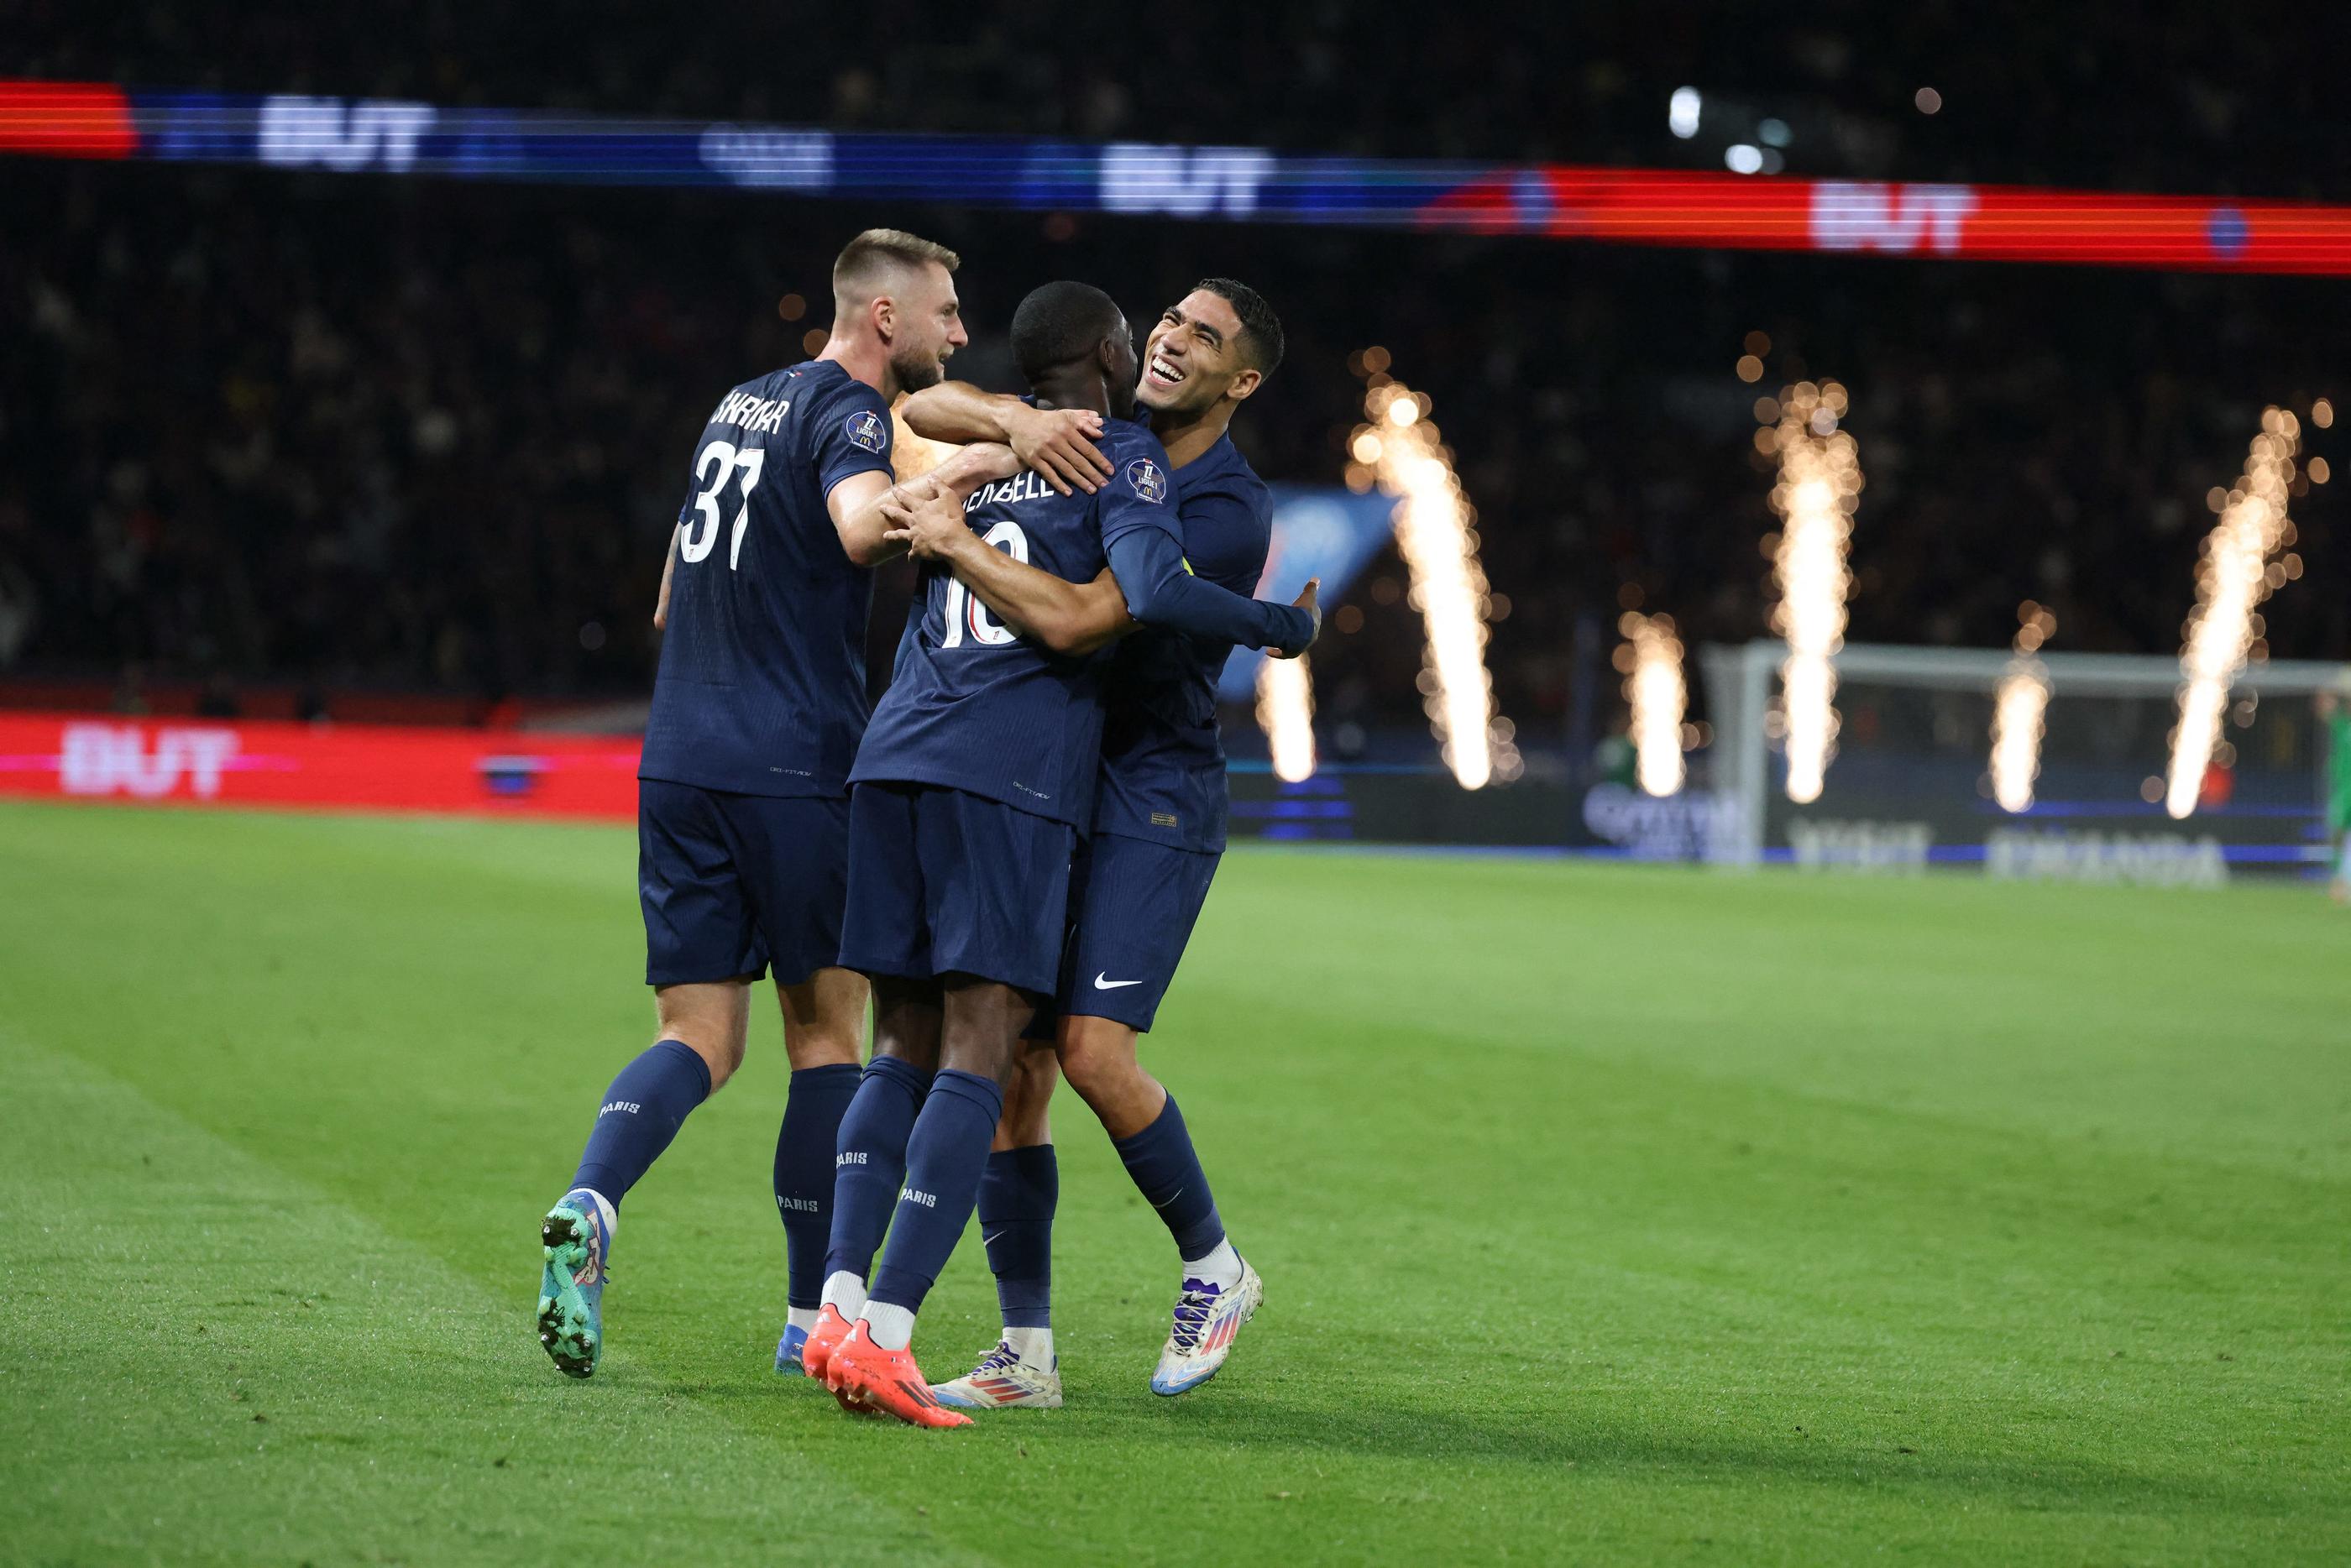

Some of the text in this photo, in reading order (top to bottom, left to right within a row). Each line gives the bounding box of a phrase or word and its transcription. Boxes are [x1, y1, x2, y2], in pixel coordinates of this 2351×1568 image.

[257, 95, 437, 173] BUT
[1097, 143, 1278, 220] BUT
[1808, 180, 1981, 256] BUT
[680, 441, 765, 572] 37
[60, 721, 241, 799] BUT
[599, 1100, 641, 1119] PARIS
[777, 1194, 818, 1212] PARIS
[900, 1188, 937, 1208] PARIS
